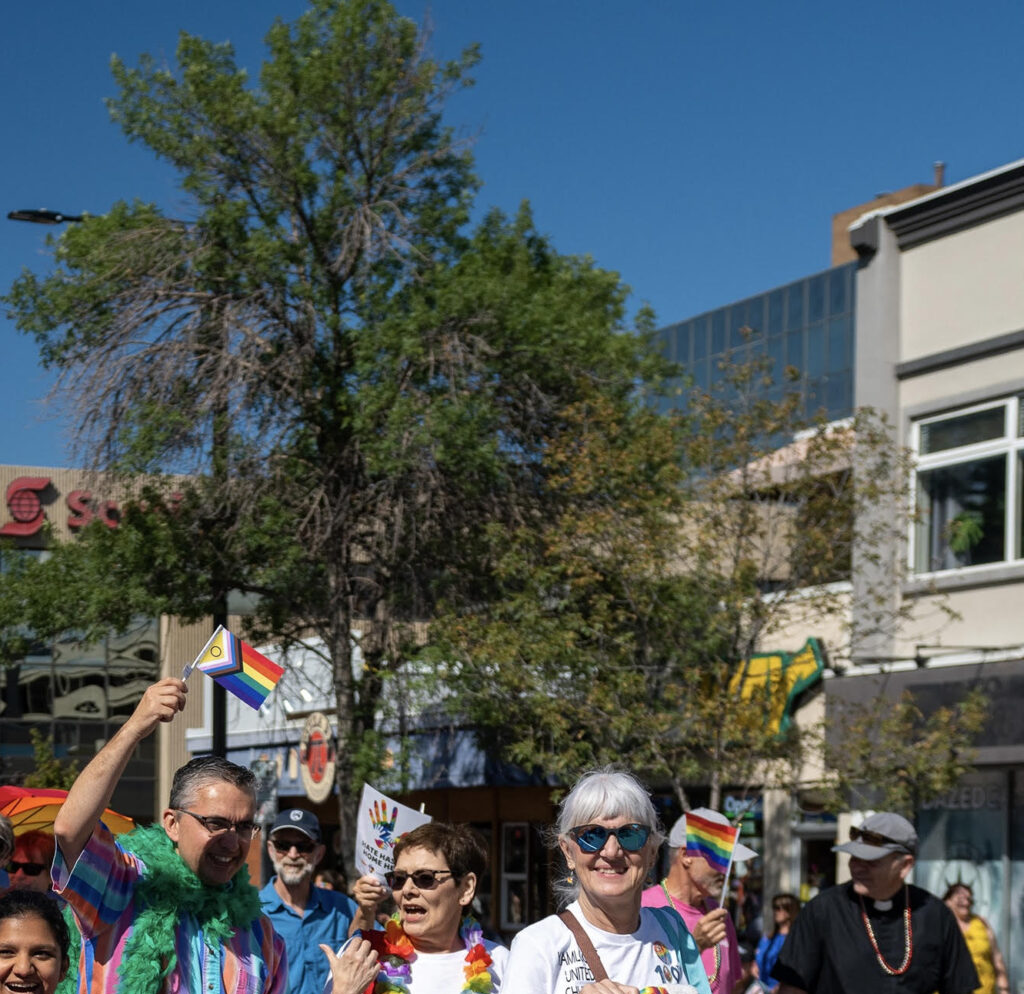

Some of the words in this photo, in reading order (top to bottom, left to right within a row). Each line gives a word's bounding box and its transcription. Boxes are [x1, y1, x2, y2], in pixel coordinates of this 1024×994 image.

[362, 841, 378, 857] HATE
[363, 849, 382, 867] HOME
[383, 862, 394, 871] HE
